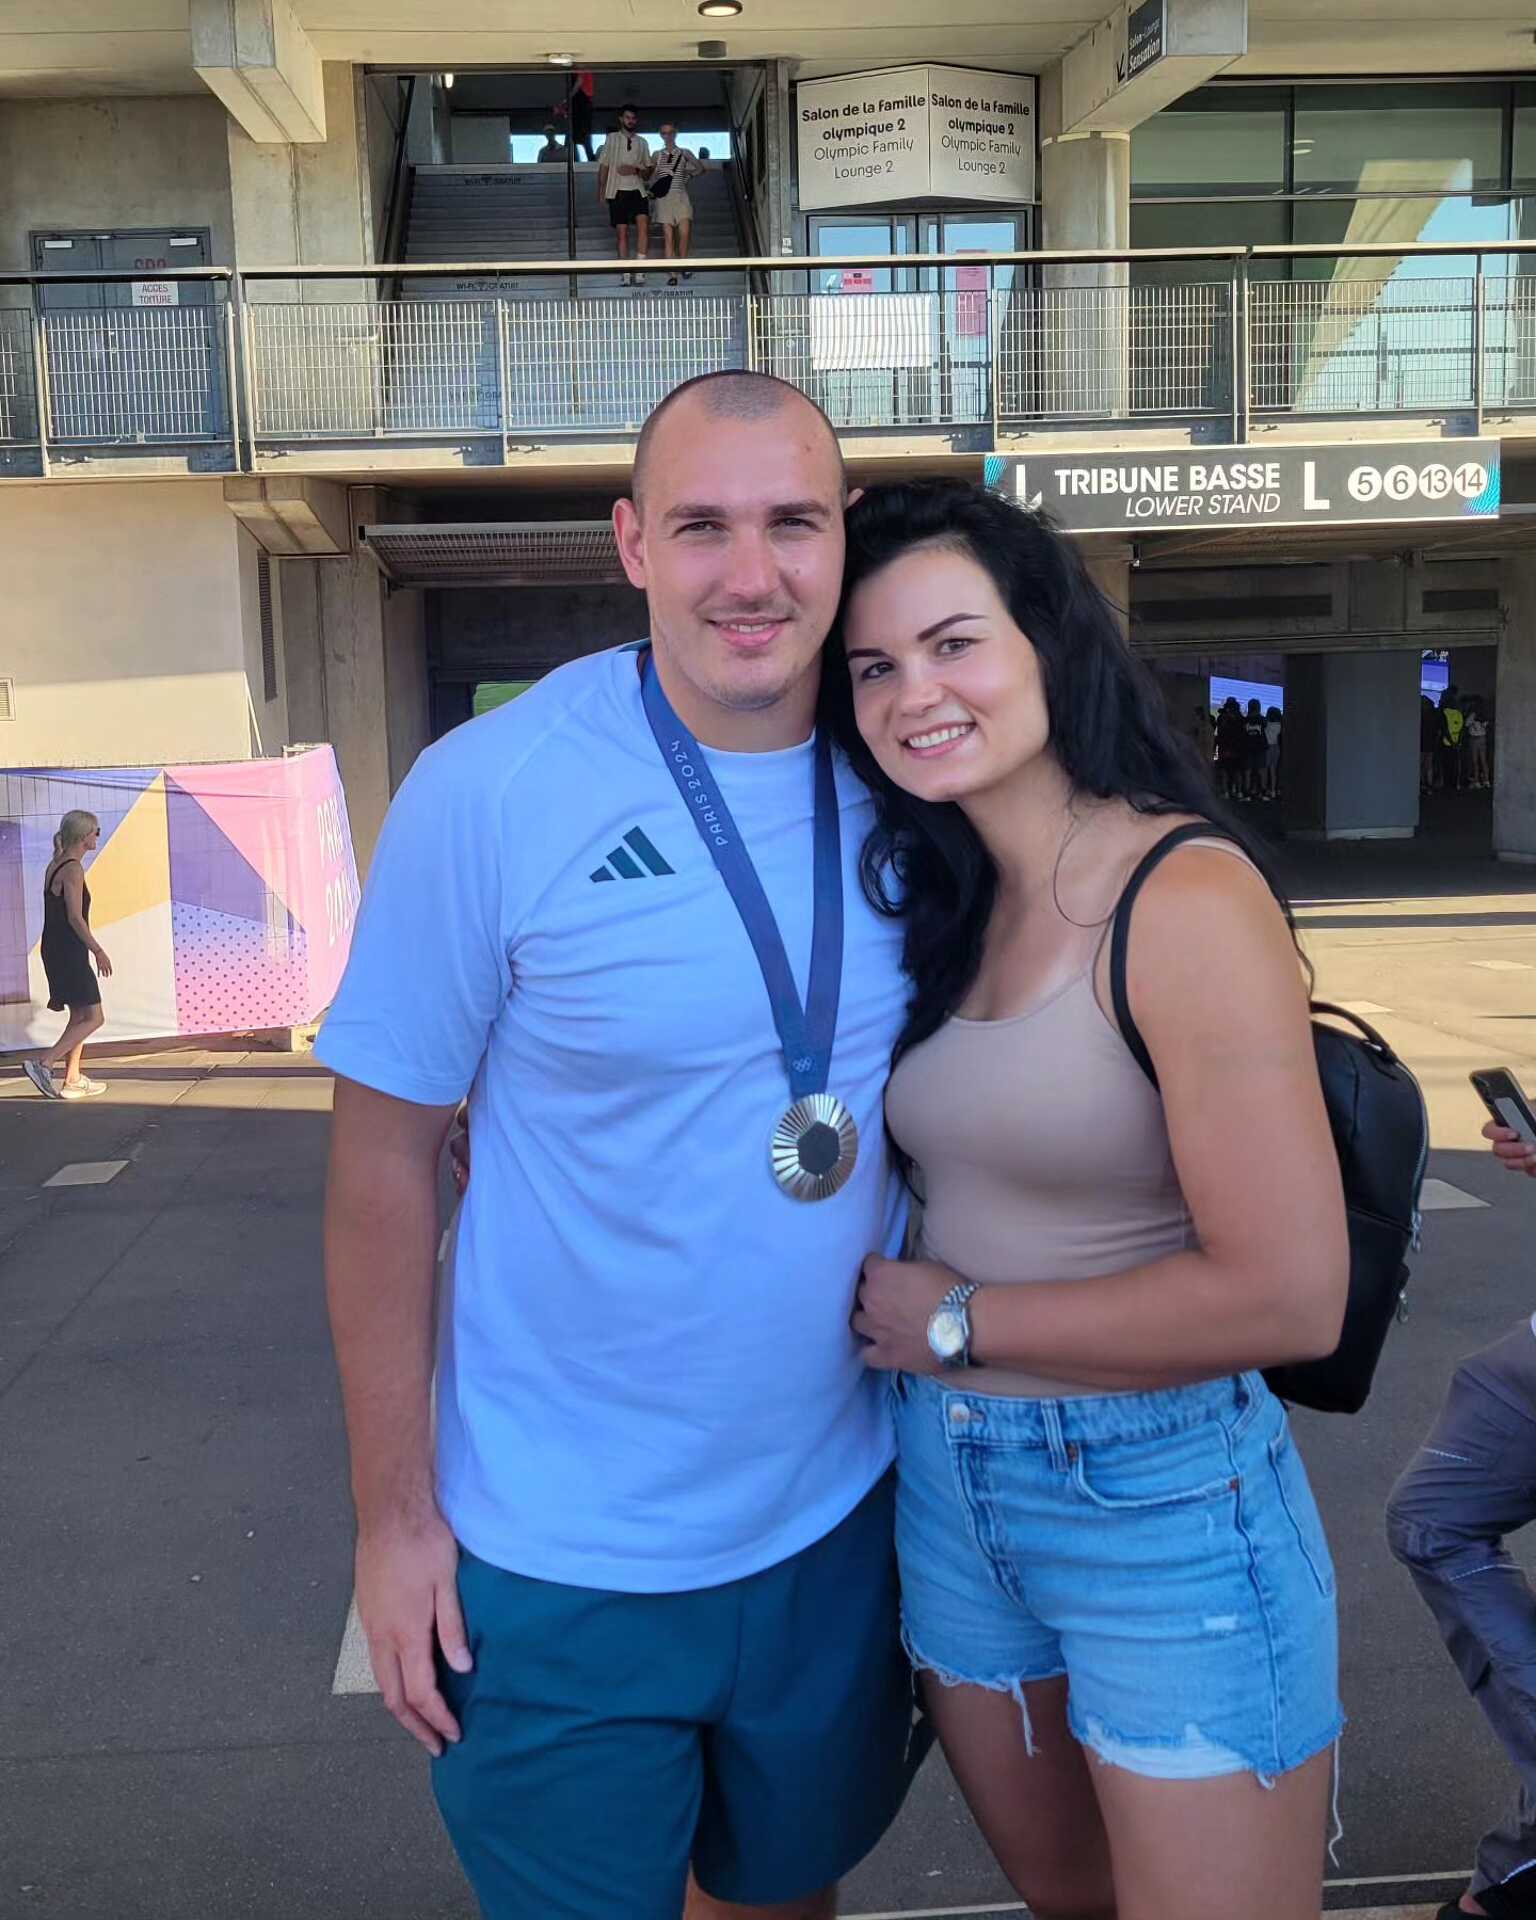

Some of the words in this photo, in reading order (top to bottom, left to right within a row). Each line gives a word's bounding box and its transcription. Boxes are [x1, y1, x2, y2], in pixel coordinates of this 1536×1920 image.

[1129, 38, 1160, 73] Sensation
[802, 108, 838, 122] Salon
[842, 104, 859, 117] de
[862, 102, 875, 114] la
[931, 93, 962, 109] Salon
[964, 98, 978, 111] de
[981, 99, 990, 112] la
[822, 122, 893, 141] olympique
[897, 118, 906, 131] 2
[948, 117, 1005, 135] olympique
[1007, 122, 1014, 135] 2
[814, 143, 869, 161] Olympic
[873, 137, 914, 153] Family
[941, 135, 986, 152] Olympic
[989, 140, 1021, 157] Family
[834, 163, 882, 179] Lounge
[885, 160, 895, 173] 2
[958, 157, 996, 175] Lounge
[999, 161, 1006, 174] 2
[1054, 466, 1179, 496] TRIBUNE
[1190, 462, 1281, 492] BASSE
[1303, 461, 1330, 510] L
[1421, 468, 1447, 493] 13
[1456, 467, 1483, 492] 14
[1125, 496, 1203, 518] LOWER
[1207, 493, 1281, 515] STAND
[671, 740, 702, 789] 2024
[695, 794, 729, 845] PARIS
